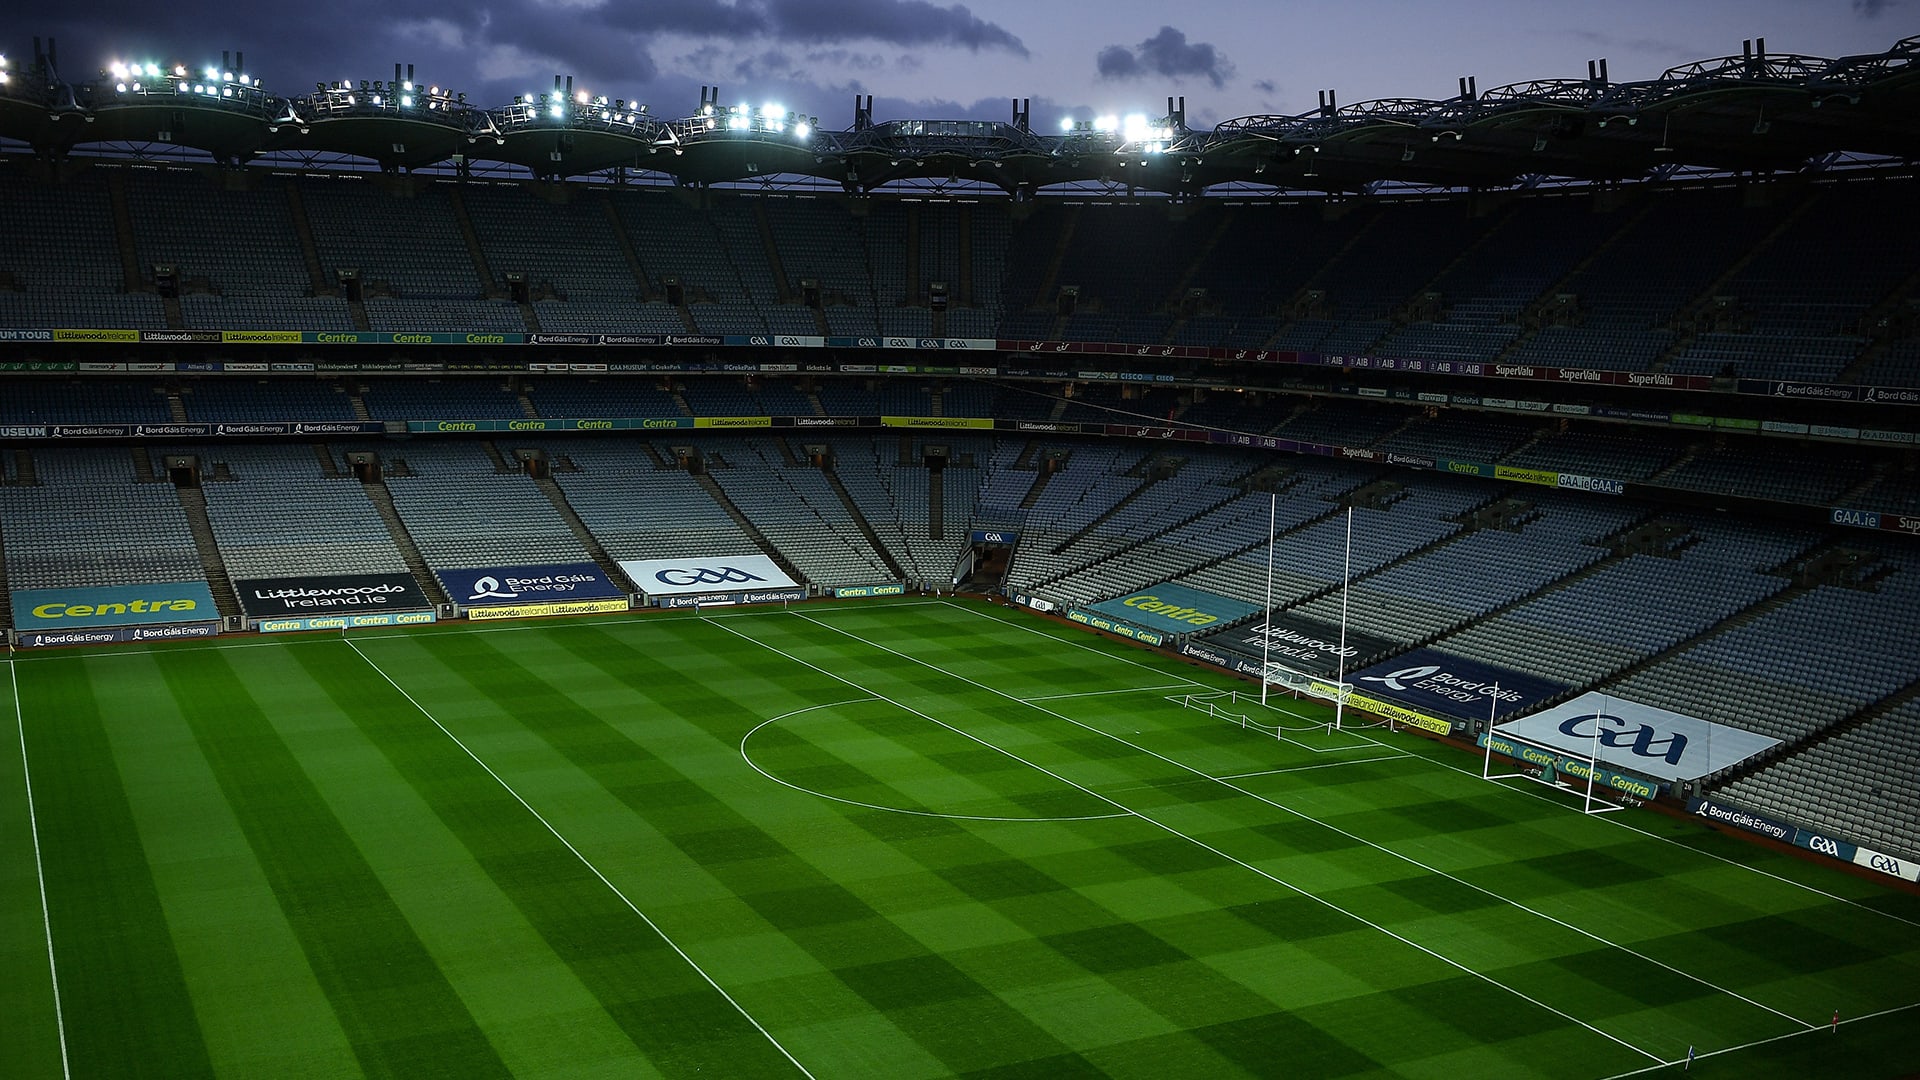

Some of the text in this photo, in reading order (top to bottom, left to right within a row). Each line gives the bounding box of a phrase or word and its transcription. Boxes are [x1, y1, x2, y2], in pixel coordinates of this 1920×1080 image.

[21, 331, 51, 340] TOUR
[317, 332, 359, 343] Centra
[393, 333, 433, 344] Centra
[466, 333, 504, 344] Centra
[538, 335, 554, 343] Bord
[568, 335, 590, 345] Energy
[606, 336, 622, 344] Bord
[635, 336, 656, 345] Energy
[700, 337, 721, 346] Energy
[1331, 356, 1344, 365] AIB
[1355, 357, 1368, 367] AIB
[1381, 358, 1395, 369] AIB
[1408, 360, 1422, 370] AIB
[1437, 361, 1451, 372] AIB
[1465, 364, 1480, 374] AIB
[1495, 364, 1534, 378] SuperValu
[1559, 368, 1601, 382] SuperValu
[1628, 373, 1674, 387] SuperValu
[1786, 385, 1806, 395] Bord
[1824, 388, 1853, 400] Energy
[1877, 390, 1899, 400] Bord
[438, 421, 476, 431] Centra
[508, 420, 546, 430] Centra
[577, 419, 613, 429] Centra
[643, 418, 677, 428] Centra
[1, 427, 45, 437] USEUM
[63, 428, 82, 436] Bord
[98, 427, 124, 438] Energy
[145, 427, 163, 435] Bord
[180, 426, 206, 437] Energy
[226, 426, 243, 434] Bord
[260, 425, 284, 435] Energy
[304, 424, 321, 432] Bord
[336, 424, 360, 434] Energy
[1237, 436, 1250, 445] AIB
[1263, 438, 1277, 447] AIB
[1342, 446, 1374, 459] SuperValu
[1448, 460, 1480, 474] Centra
[1559, 474, 1590, 489] GAA.ie
[1590, 478, 1624, 494] GAA.ie
[1833, 509, 1877, 527] GAA.ie
[505, 573, 597, 586] Bord Gáis
[655, 566, 769, 586] GAA
[254, 584, 406, 600] Littlewoods
[509, 582, 576, 594] Energy
[839, 588, 867, 597] Centra
[873, 586, 900, 595] Centra
[285, 594, 388, 609] Ireland.ie
[677, 598, 693, 606] Bord
[779, 592, 801, 601] Energy
[31, 599, 197, 619] Centra
[1123, 595, 1218, 625] Centra
[354, 616, 389, 626] Centra
[396, 614, 431, 624] Centra
[1069, 611, 1088, 624] Centra
[264, 621, 301, 631] Centra
[308, 618, 345, 629] Centra
[1091, 617, 1110, 630] Centra
[143, 628, 163, 638] Bord
[182, 625, 209, 638] Energy
[1114, 624, 1134, 637] Centra
[45, 634, 65, 645] Bord
[85, 632, 114, 644] Energy
[1137, 630, 1158, 645] Centra
[1250, 623, 1359, 657] Littlewoods
[1188, 647, 1200, 657] Bord
[1210, 653, 1227, 666] Energy
[1242, 663, 1256, 674] Bord
[1412, 680, 1482, 703] Energy
[1430, 672, 1523, 703] Bord Gáis
[1558, 714, 1688, 766] GAA
[1482, 737, 1513, 755] Centra
[1522, 747, 1553, 767] Centr
[1565, 760, 1603, 782] Centra
[1610, 775, 1649, 797] Centra
[1684, 782, 1692, 791] 20
[1709, 806, 1787, 839] Bord Gáis Energy
[1809, 835, 1840, 857] GAA
[1870, 854, 1901, 876] GAA
